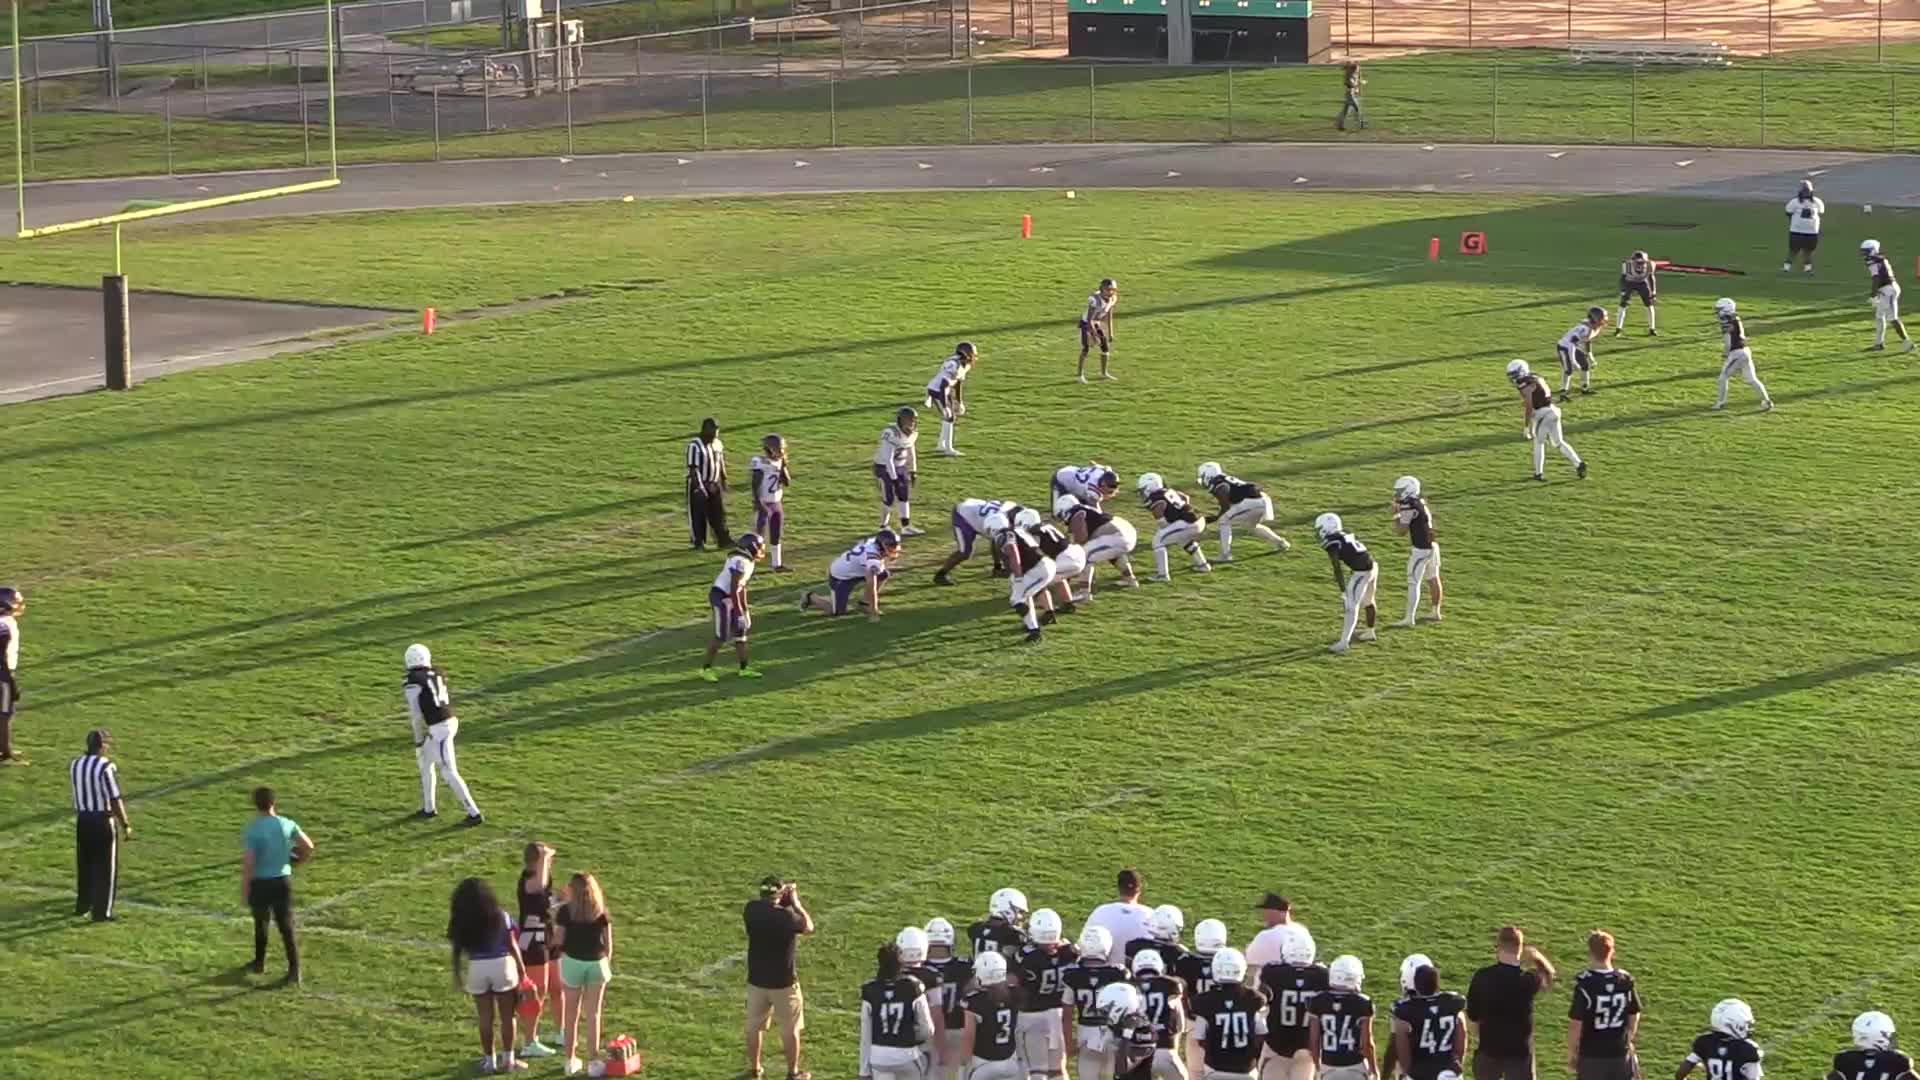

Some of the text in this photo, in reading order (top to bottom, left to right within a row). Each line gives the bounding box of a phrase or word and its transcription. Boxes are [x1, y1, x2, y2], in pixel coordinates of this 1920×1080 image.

[1464, 234, 1480, 249] G
[879, 1001, 905, 1035] 17
[995, 1009, 1012, 1044] 3
[1215, 1011, 1249, 1049] 70
[1594, 993, 1628, 1031] 52
[1320, 1014, 1356, 1052] 84
[1419, 1015, 1456, 1055] 42
